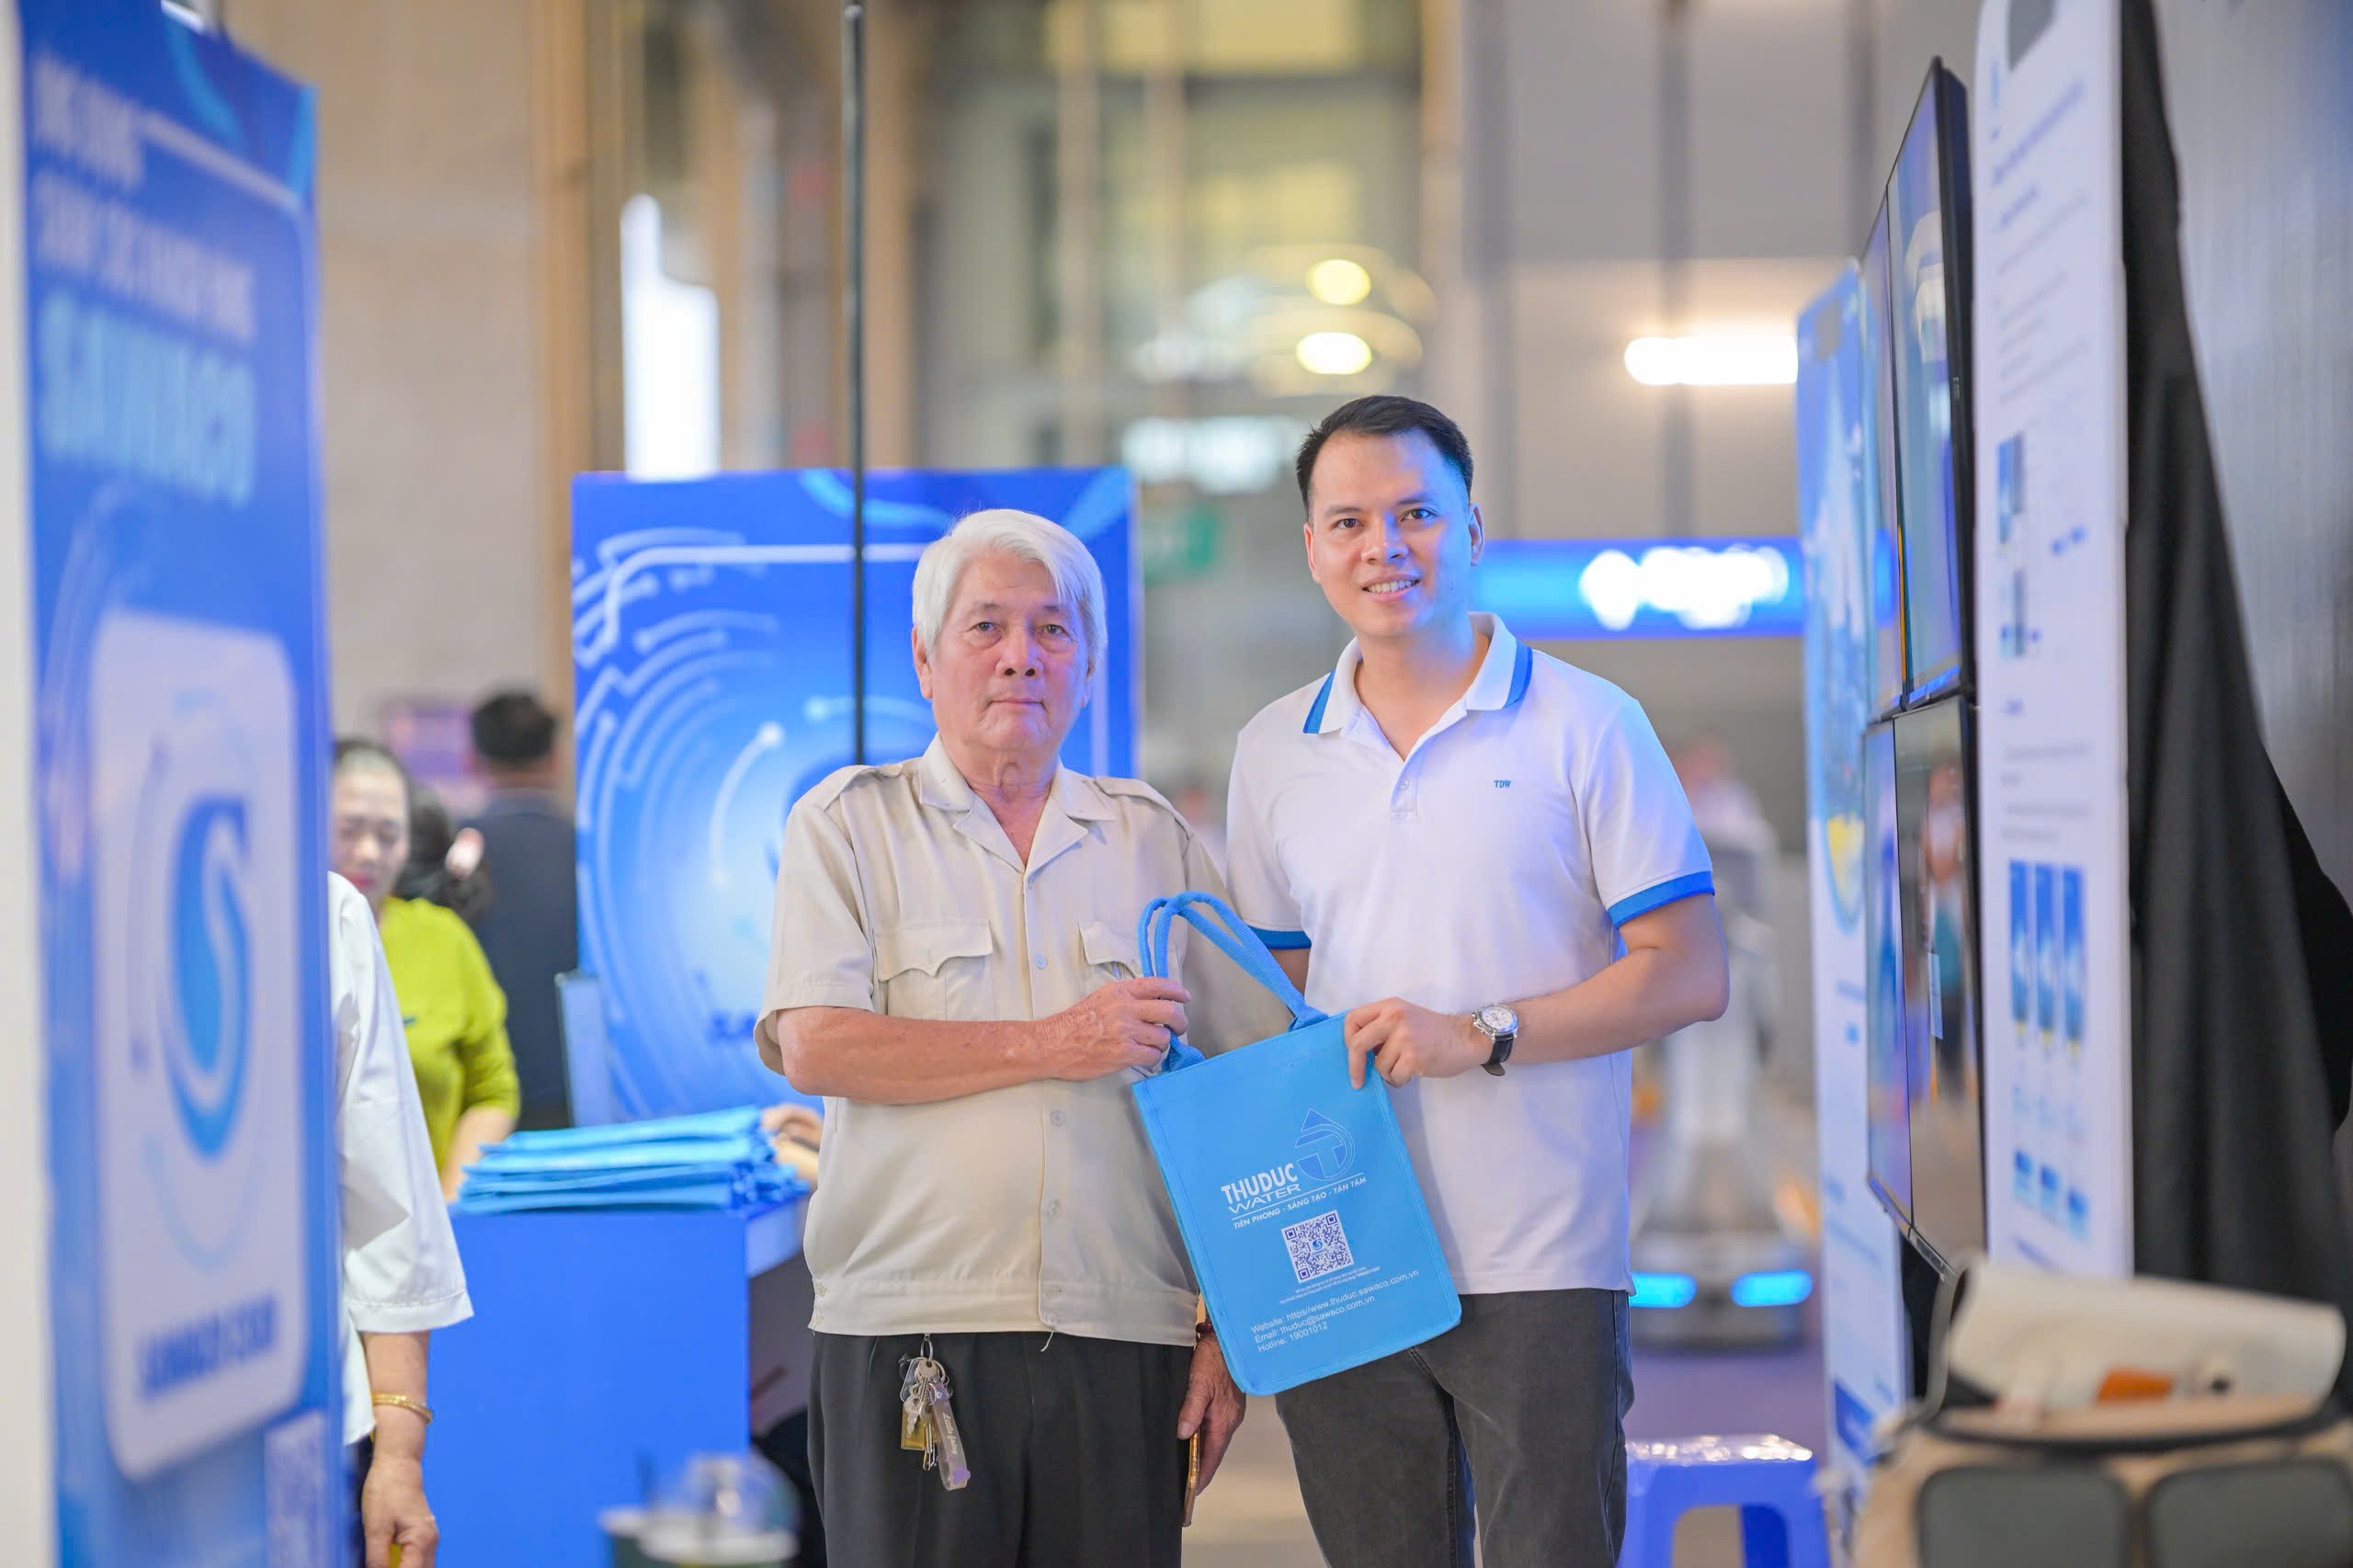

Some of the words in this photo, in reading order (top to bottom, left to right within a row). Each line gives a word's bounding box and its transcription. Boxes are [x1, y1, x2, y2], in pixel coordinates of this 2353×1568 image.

[1494, 779, 1512, 789] TDW
[1221, 1163, 1298, 1204] THUDUC
[1228, 1184, 1301, 1213] WATER
[1252, 1208, 1280, 1222] PHONG
[1251, 1316, 1285, 1333] Website:
[1255, 1329, 1279, 1344] Email:
[1280, 1295, 1375, 1334] thuduc@sawaco.com.vn
[1257, 1337, 1287, 1353] Hotline:
[1290, 1322, 1328, 1341] 19001012
